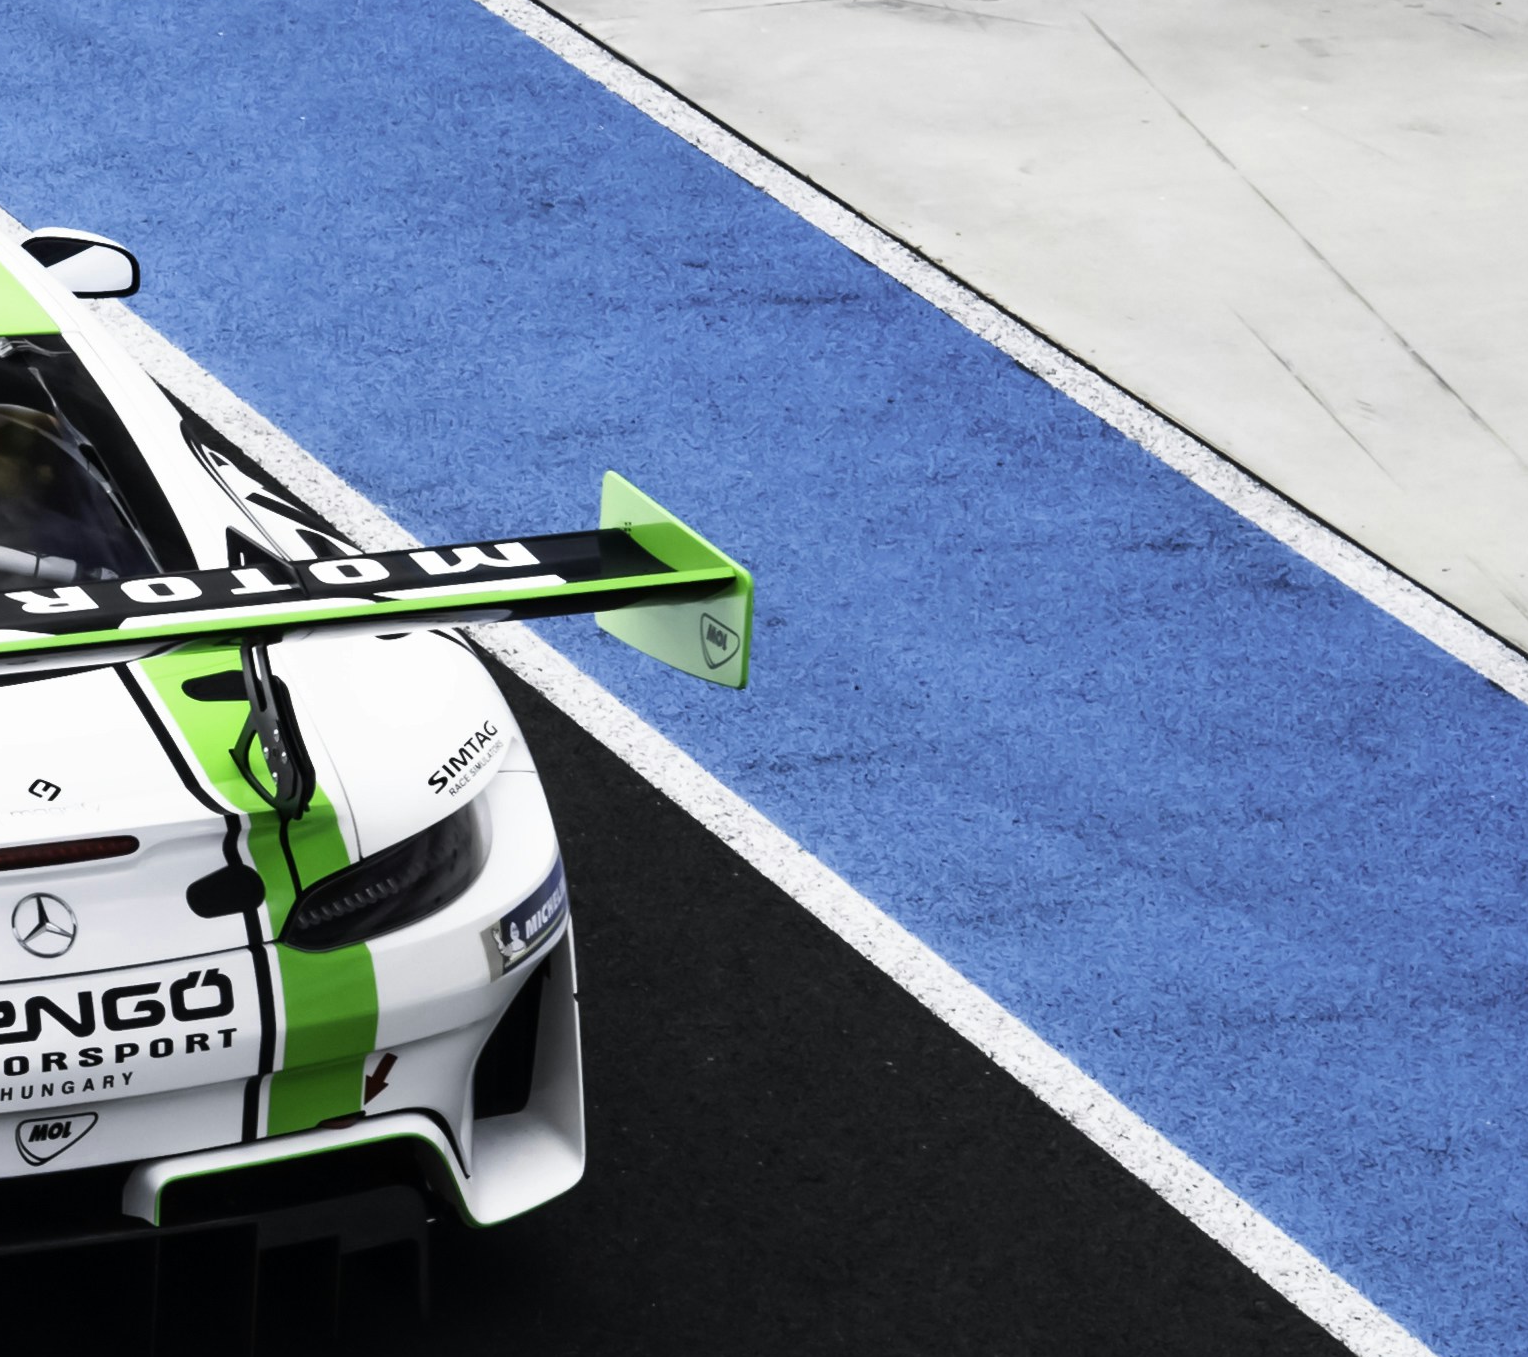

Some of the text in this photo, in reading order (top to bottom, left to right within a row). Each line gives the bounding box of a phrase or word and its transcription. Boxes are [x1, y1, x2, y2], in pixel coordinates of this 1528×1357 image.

[427, 720, 498, 795] SIMTAG
[448, 773, 472, 797] RACE
[0, 1071, 134, 1102] HUNGARY
[28, 1120, 72, 1143] MOL
